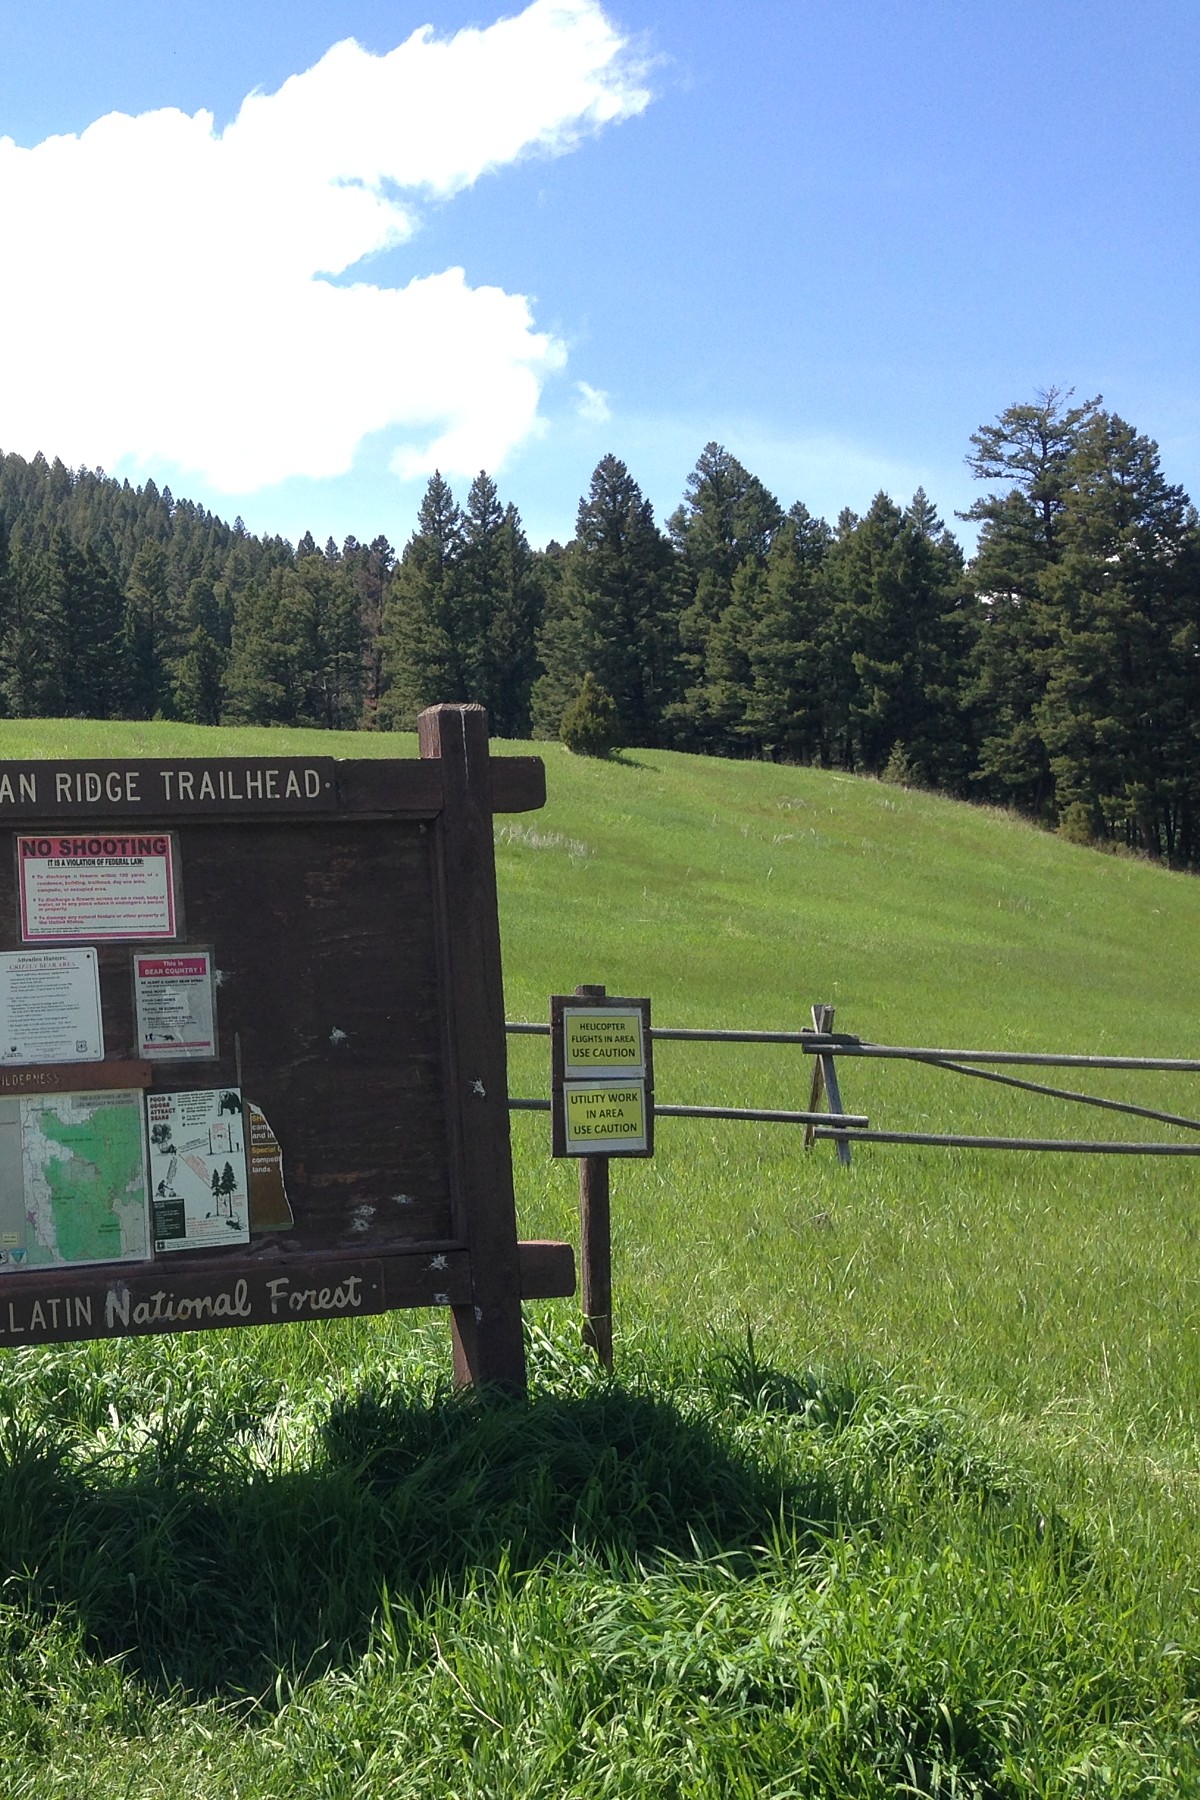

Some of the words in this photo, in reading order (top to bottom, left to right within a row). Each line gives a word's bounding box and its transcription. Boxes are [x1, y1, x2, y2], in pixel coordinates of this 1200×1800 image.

[56, 772, 140, 801] RIDGE
[160, 769, 320, 800] TRAILHEAD
[22, 840, 51, 856] NO
[59, 838, 166, 856] SHOOTING
[105, 858, 130, 866] FEDERAL
[579, 1022, 625, 1031] HELICOPTER
[571, 1035, 603, 1043] FLIGHTS
[604, 1035, 612, 1043] IN
[614, 1035, 635, 1043] AREA
[572, 1048, 590, 1058] USE
[592, 1048, 635, 1058] CAUTION
[571, 1094, 605, 1104] UTILITY
[608, 1093, 638, 1102] WORK
[586, 1110, 596, 1119] IN
[599, 1108, 624, 1118] AREA
[574, 1125, 592, 1134] USE
[594, 1123, 637, 1134] CAUTION
[104, 1279, 251, 1328] National
[266, 1276, 362, 1315] Forest
